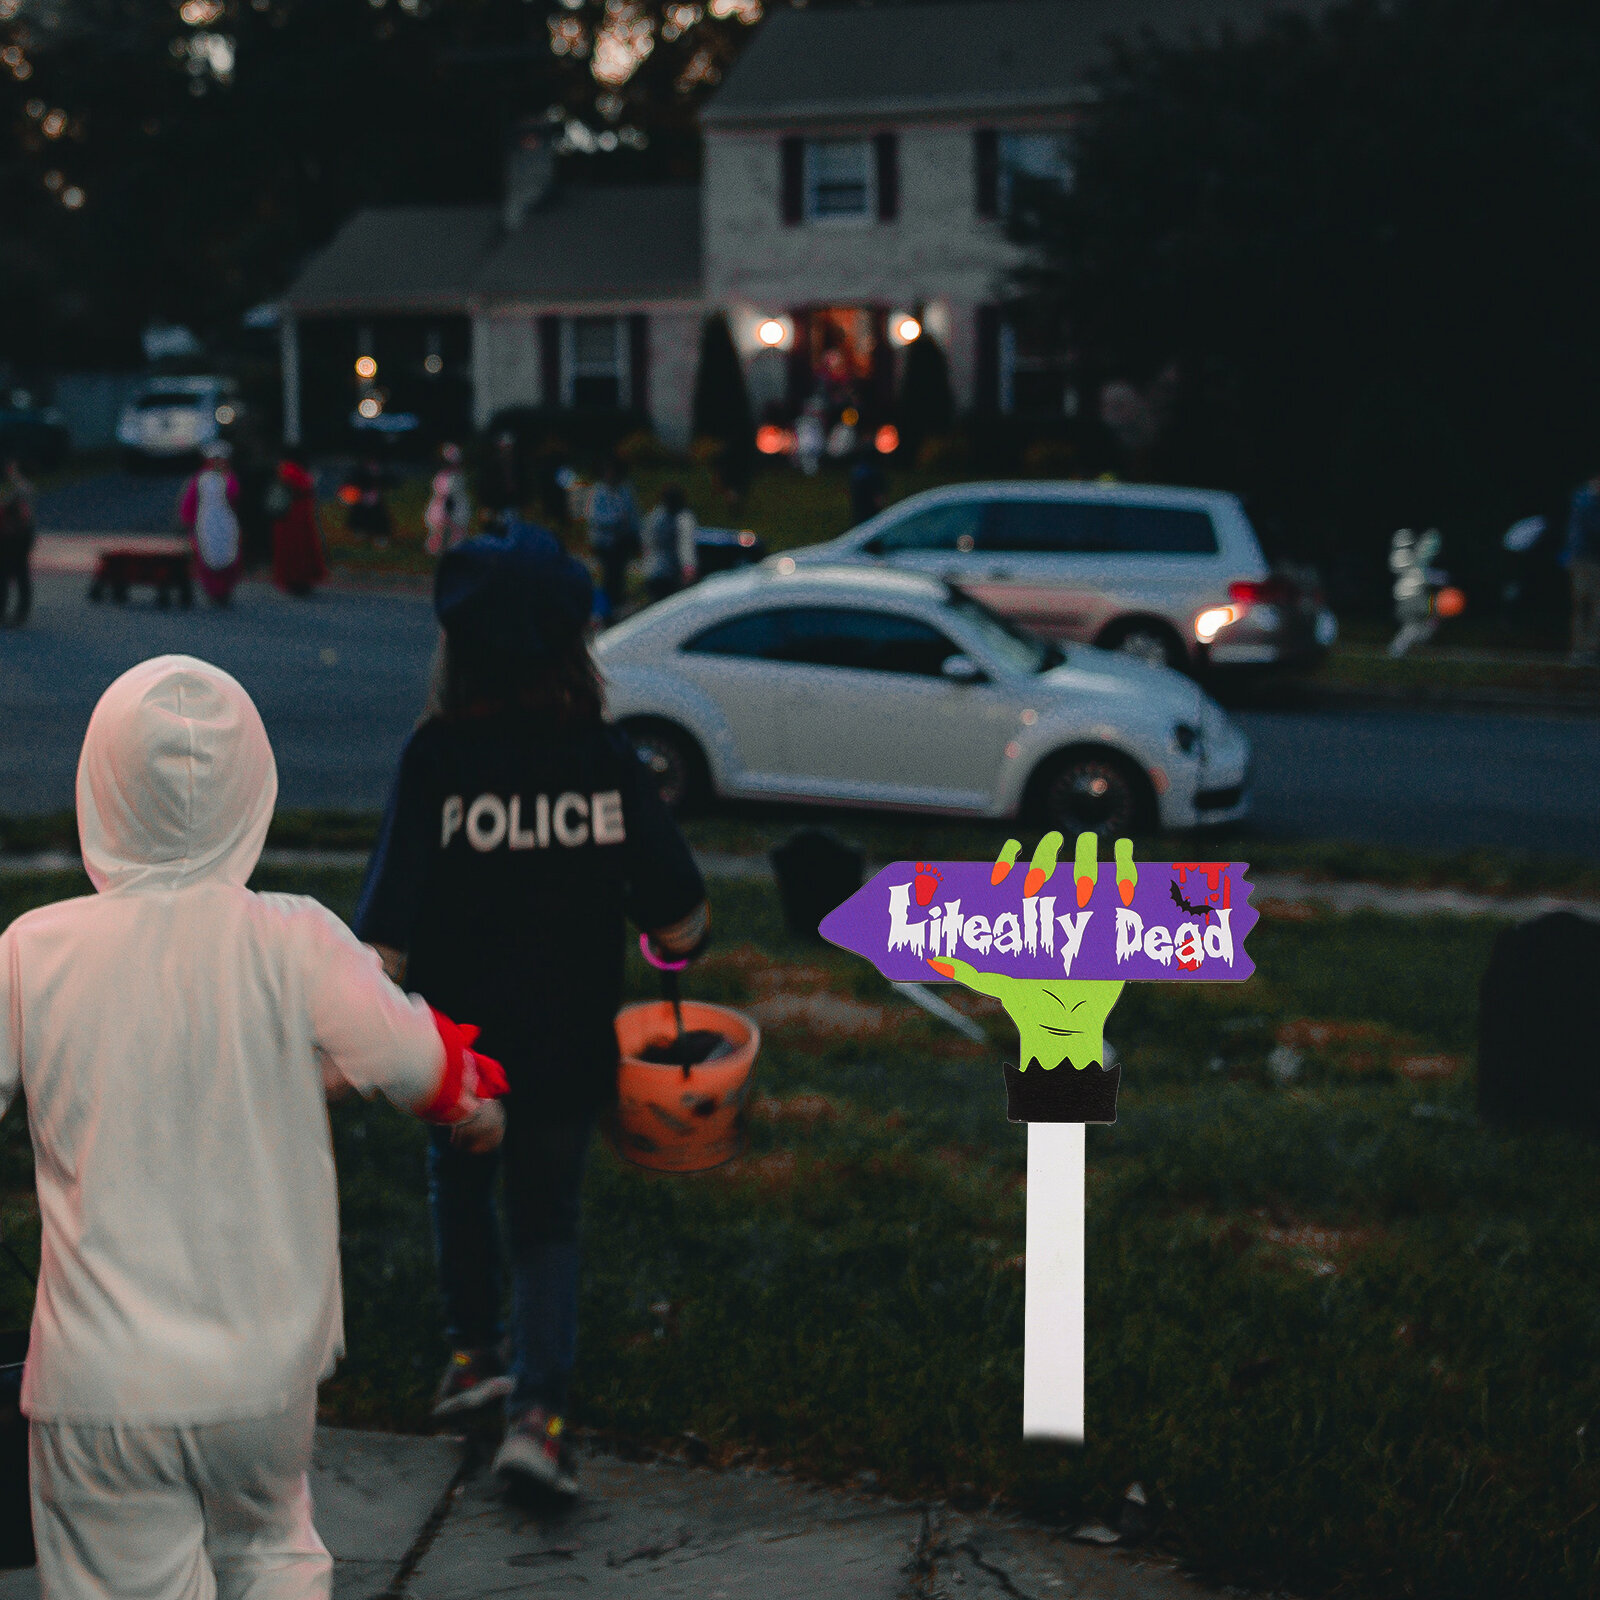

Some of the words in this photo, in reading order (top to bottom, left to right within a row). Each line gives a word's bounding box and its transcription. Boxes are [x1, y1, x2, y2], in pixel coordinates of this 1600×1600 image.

[441, 790, 626, 852] POLICE
[887, 882, 1094, 977] Liteally
[1114, 906, 1234, 968] Dead
